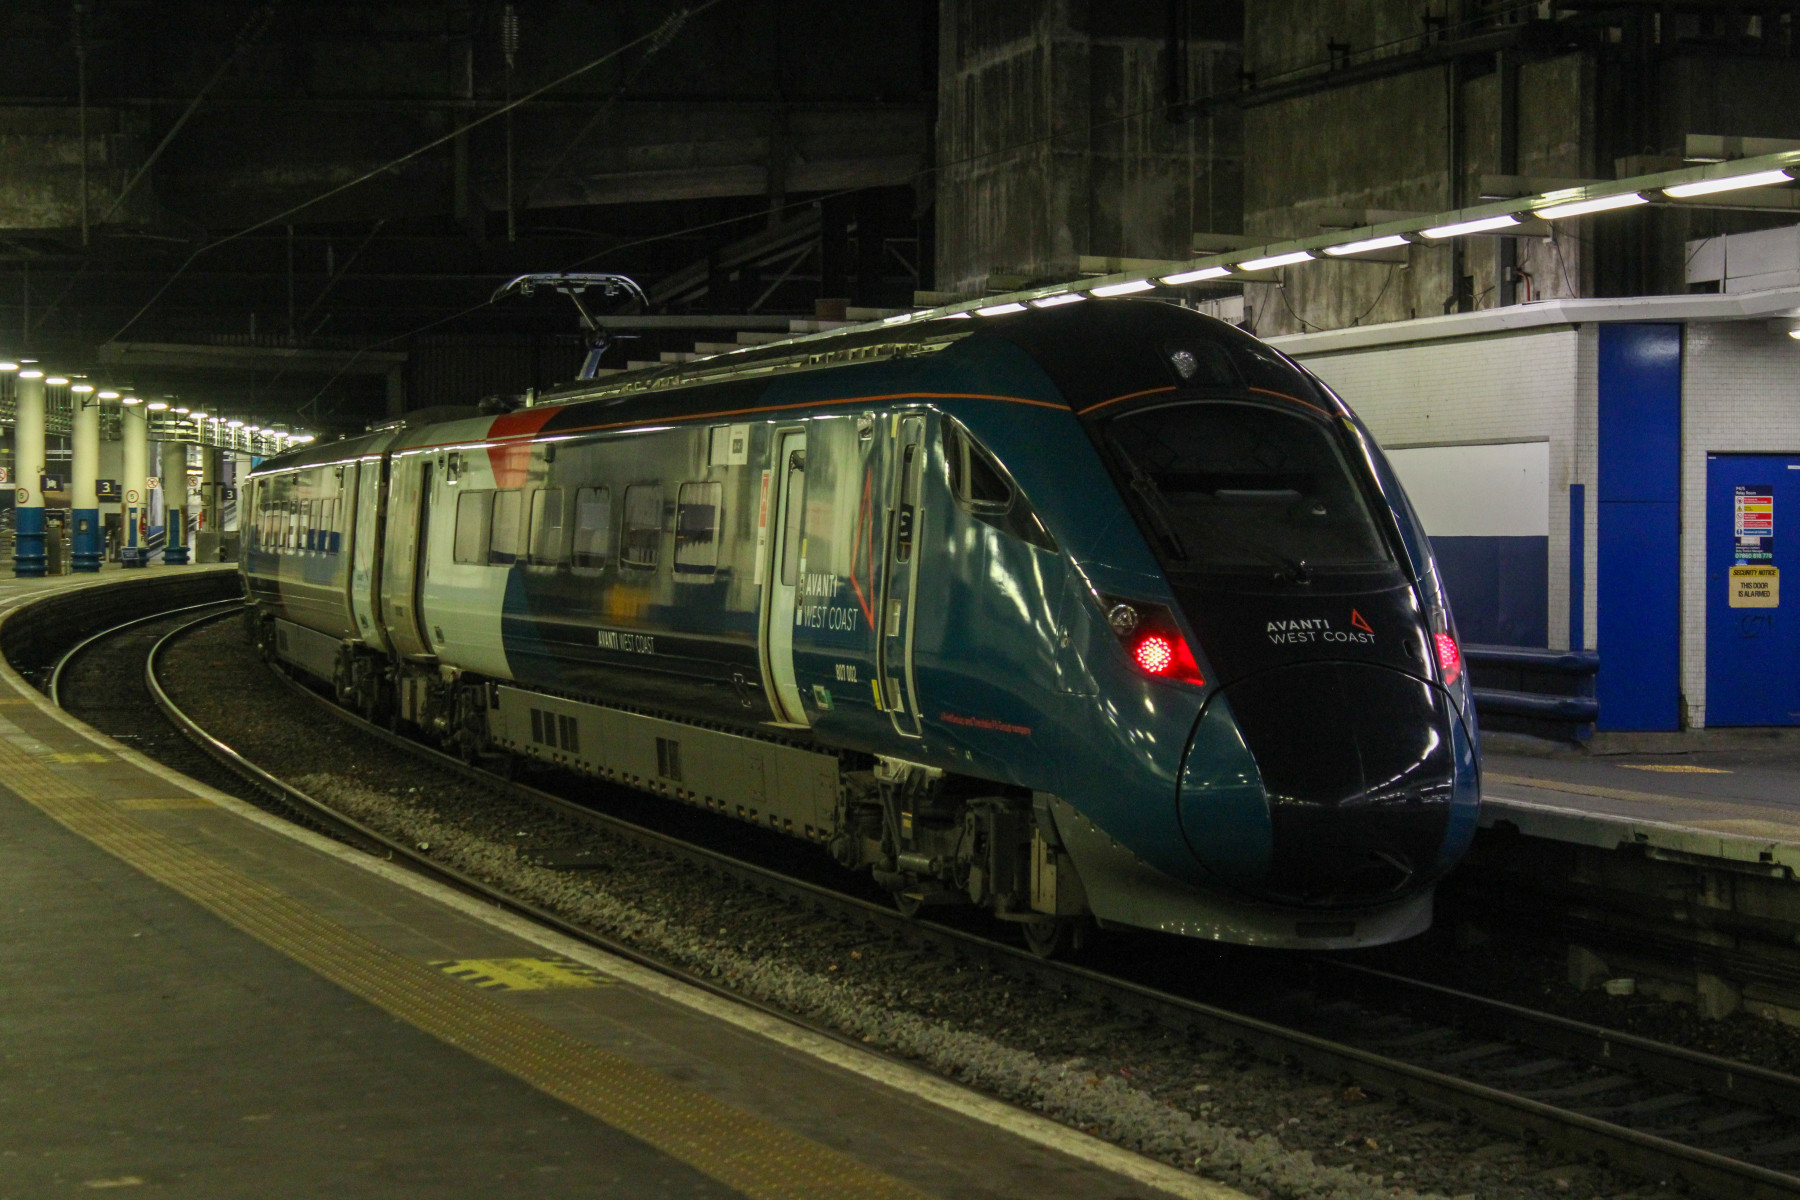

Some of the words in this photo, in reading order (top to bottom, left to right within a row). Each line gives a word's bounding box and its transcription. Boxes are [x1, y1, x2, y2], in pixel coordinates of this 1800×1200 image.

[102, 482, 111, 493] 3
[226, 490, 234, 499] 3
[805, 573, 838, 598] AVANTI
[1738, 590, 1744, 598] IS
[1744, 590, 1771, 598] ALARMED
[804, 605, 828, 628] WEST
[828, 607, 859, 632] COAST
[1267, 619, 1330, 633] AVANTI
[598, 630, 619, 650] AVANTI
[619, 633, 635, 652] WEST
[635, 635, 655, 655] COAST
[1269, 632, 1316, 645] WEST
[1323, 631, 1375, 644] COAST
[846, 665, 858, 683] 002
